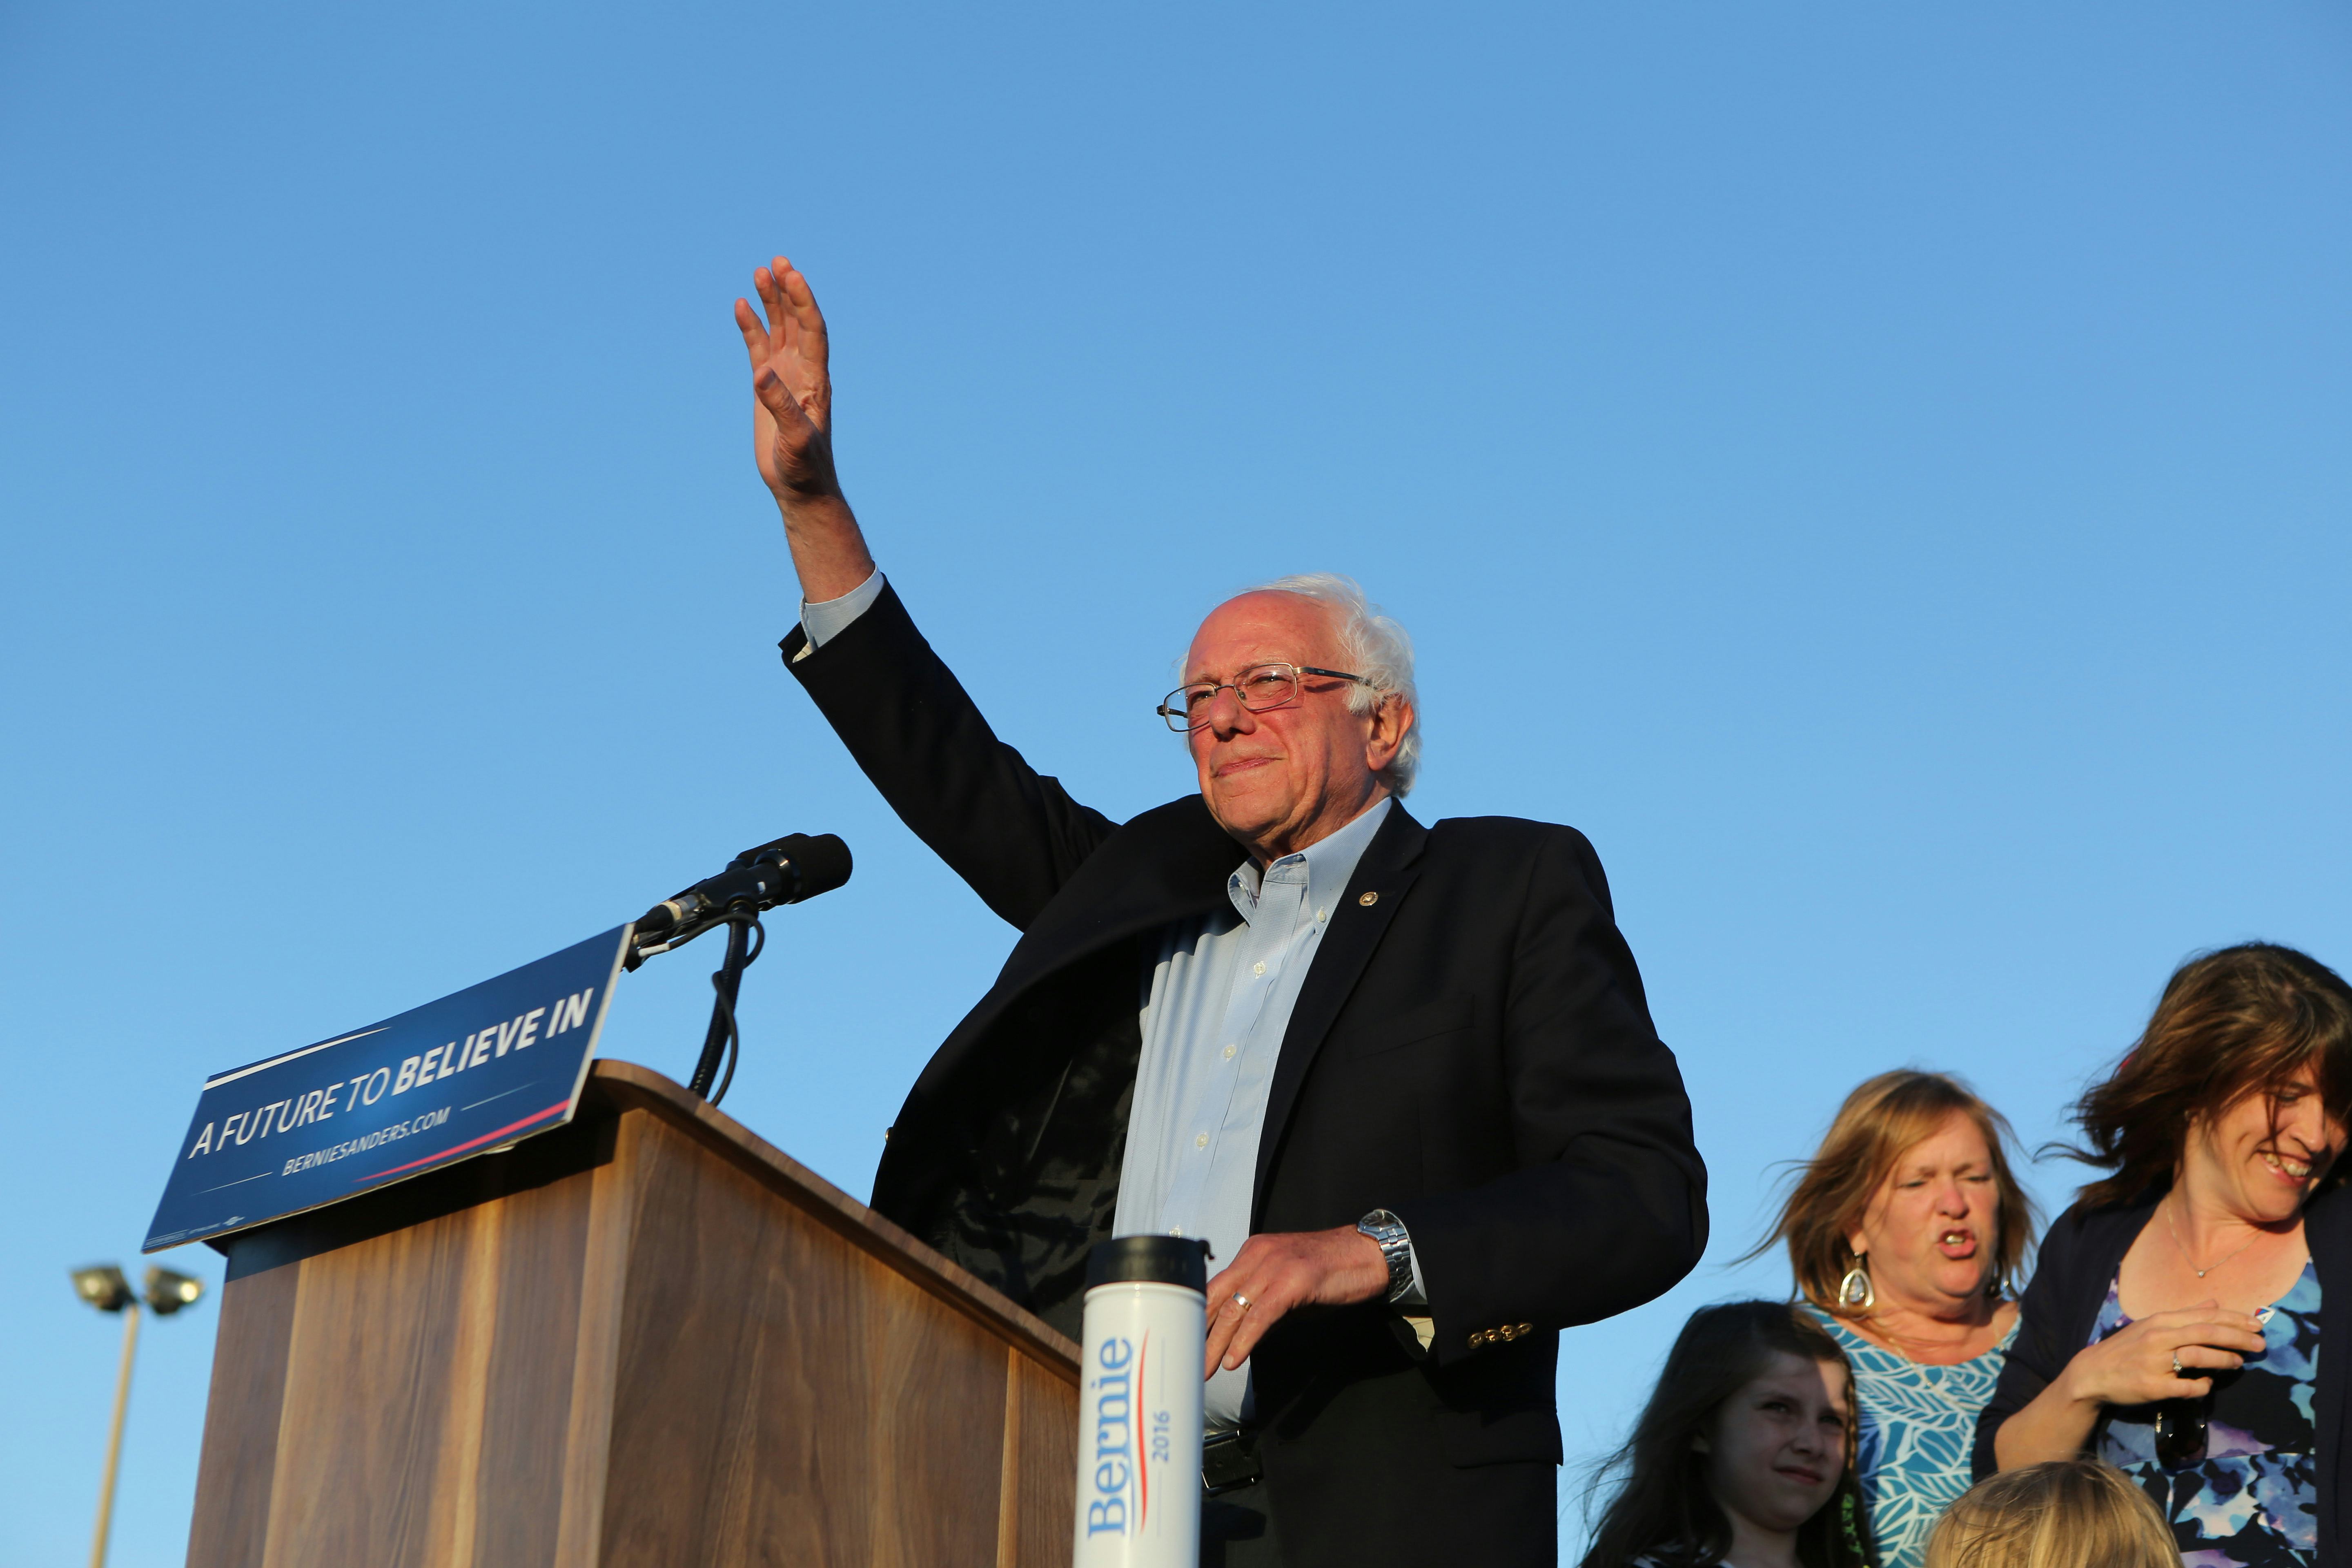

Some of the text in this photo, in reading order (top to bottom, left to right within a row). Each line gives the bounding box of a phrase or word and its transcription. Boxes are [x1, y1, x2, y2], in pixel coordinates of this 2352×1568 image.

[188, 987, 594, 1159] A FUTURE TO BELIEVE IN
[282, 1106, 451, 1176] BERNIESANDERS.COM
[1088, 1337, 1134, 1539] Bernie
[1152, 1411, 1171, 1462] 2016
